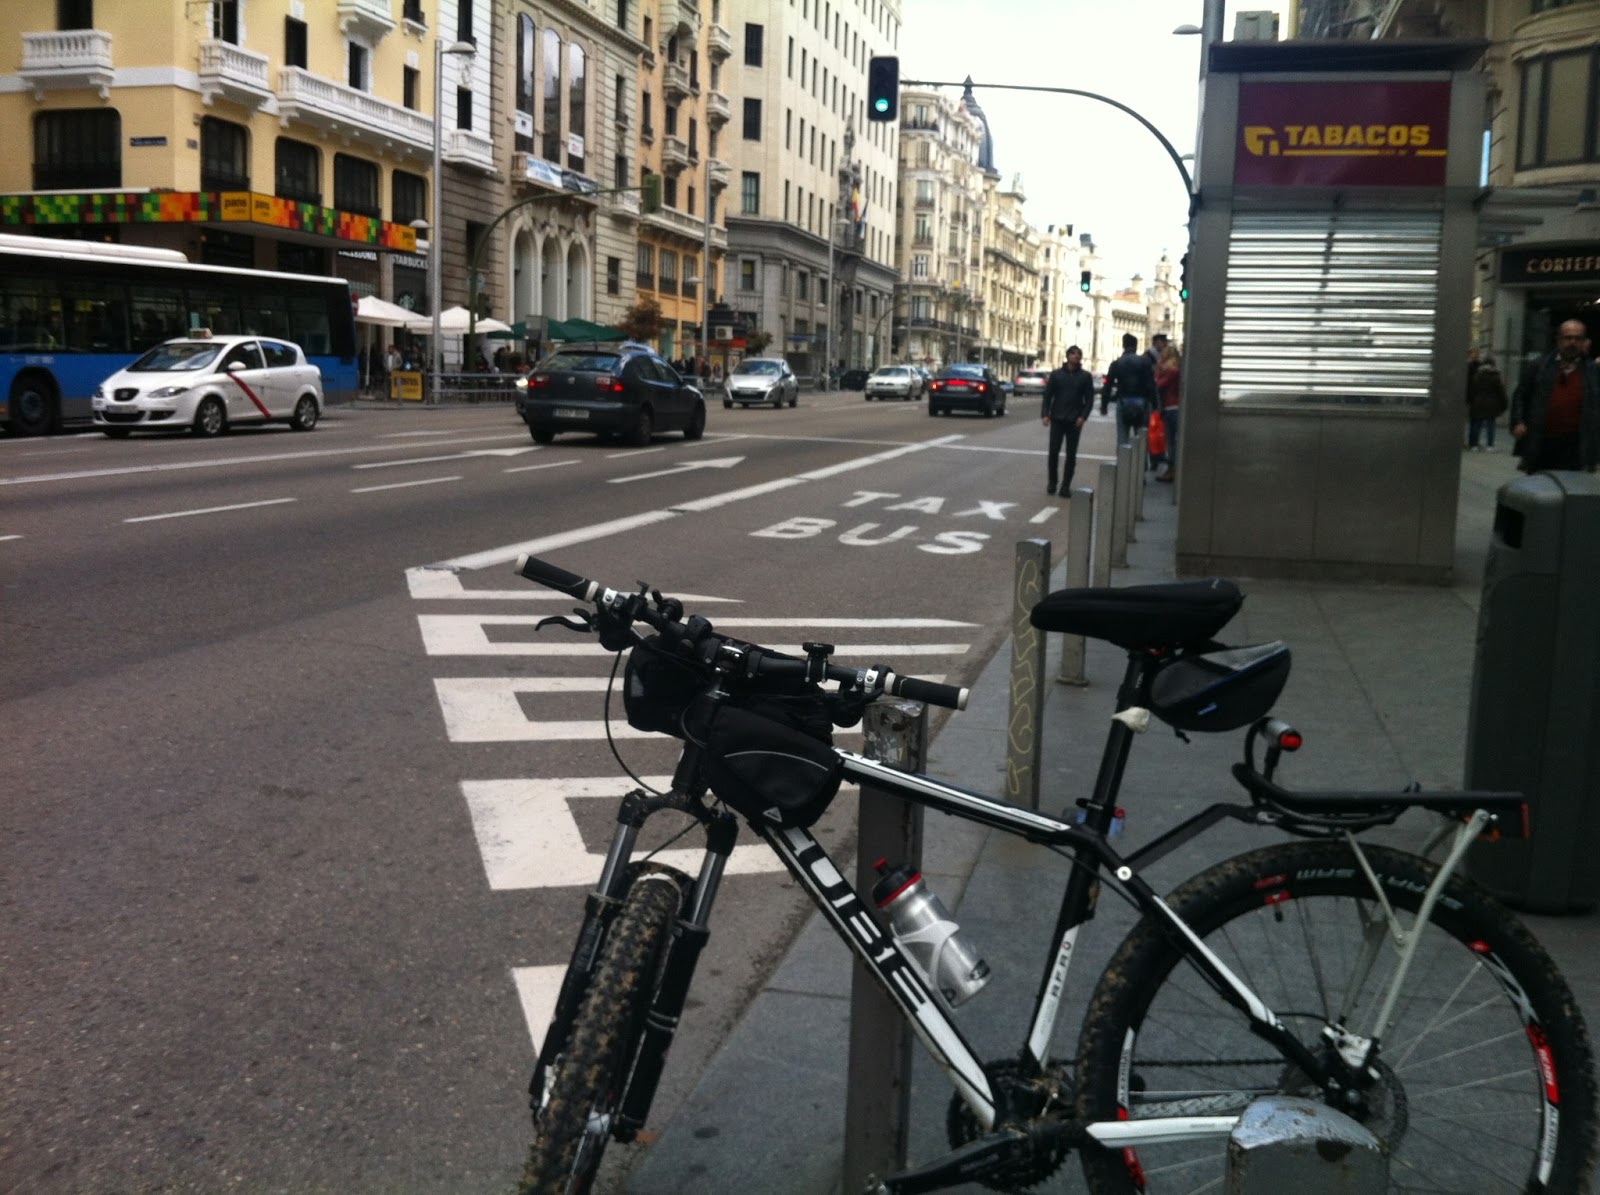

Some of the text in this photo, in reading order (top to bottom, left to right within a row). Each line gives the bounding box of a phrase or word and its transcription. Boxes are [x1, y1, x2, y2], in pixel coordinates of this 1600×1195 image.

[1284, 125, 1430, 146] TABACOS
[390, 254, 429, 269] STARBUCKS
[841, 490, 1059, 524] TAXI
[747, 516, 991, 554] BUS
